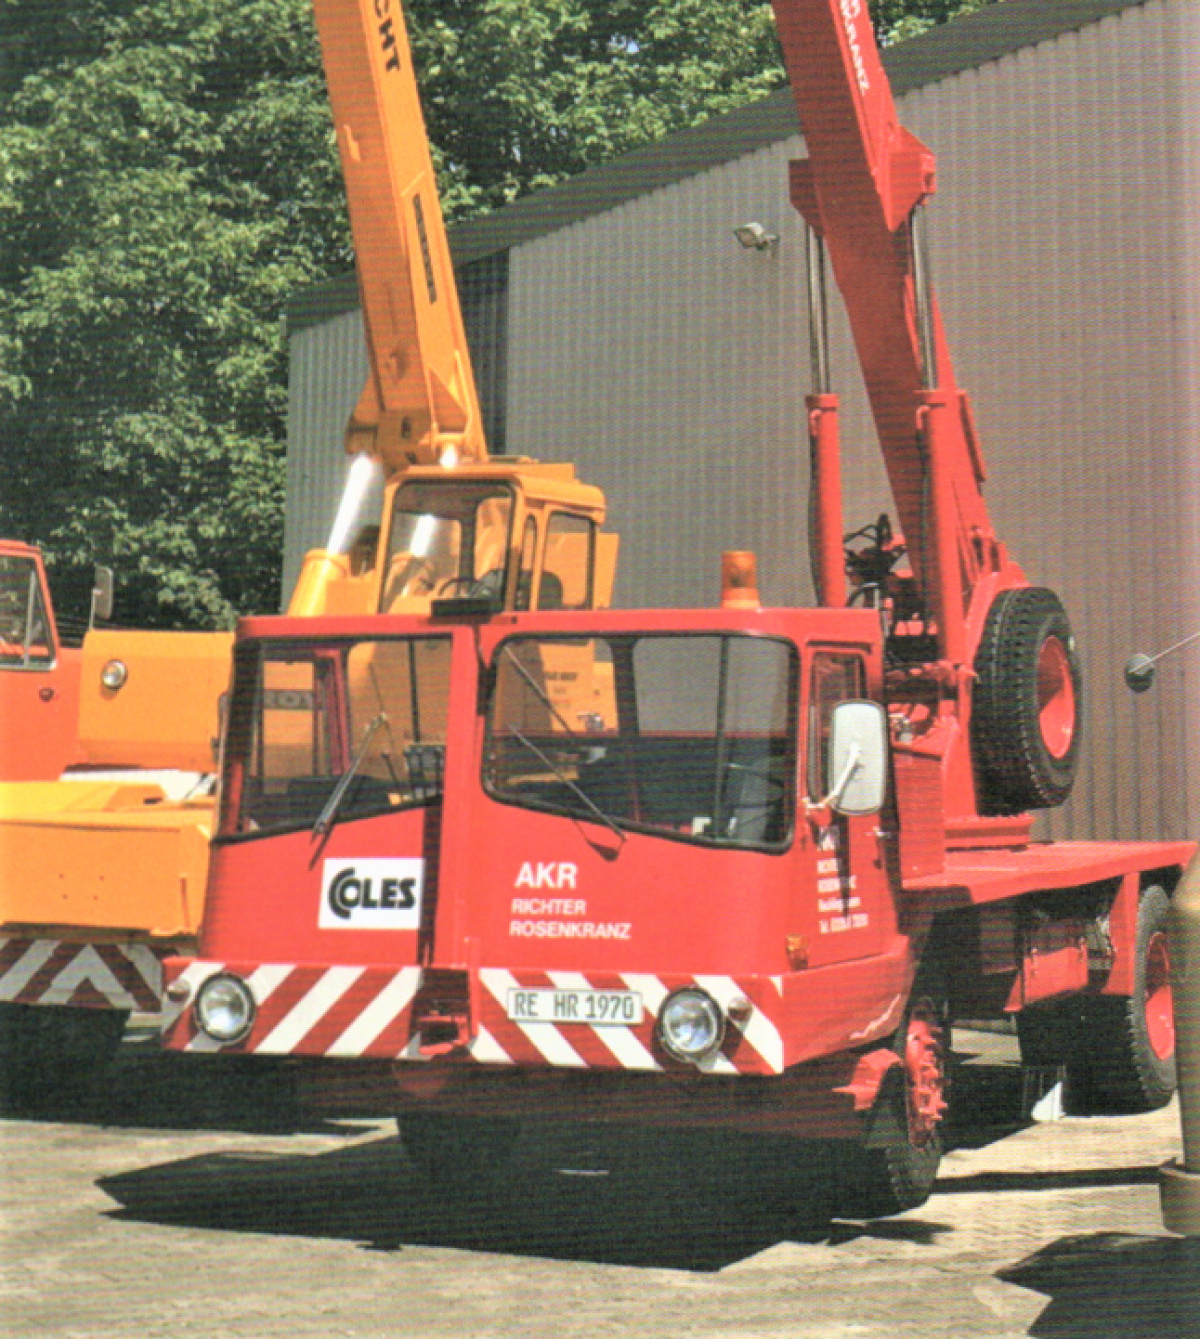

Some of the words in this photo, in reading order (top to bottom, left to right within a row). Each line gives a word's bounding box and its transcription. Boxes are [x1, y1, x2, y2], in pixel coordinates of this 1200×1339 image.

[514, 861, 578, 889] AKR
[328, 866, 416, 920] COLES
[511, 898, 587, 915] RICHTER
[509, 919, 632, 940] ROSENKRANZ
[514, 992, 540, 1017] RE
[554, 993, 579, 1018] HR
[585, 994, 635, 1020] 1970
